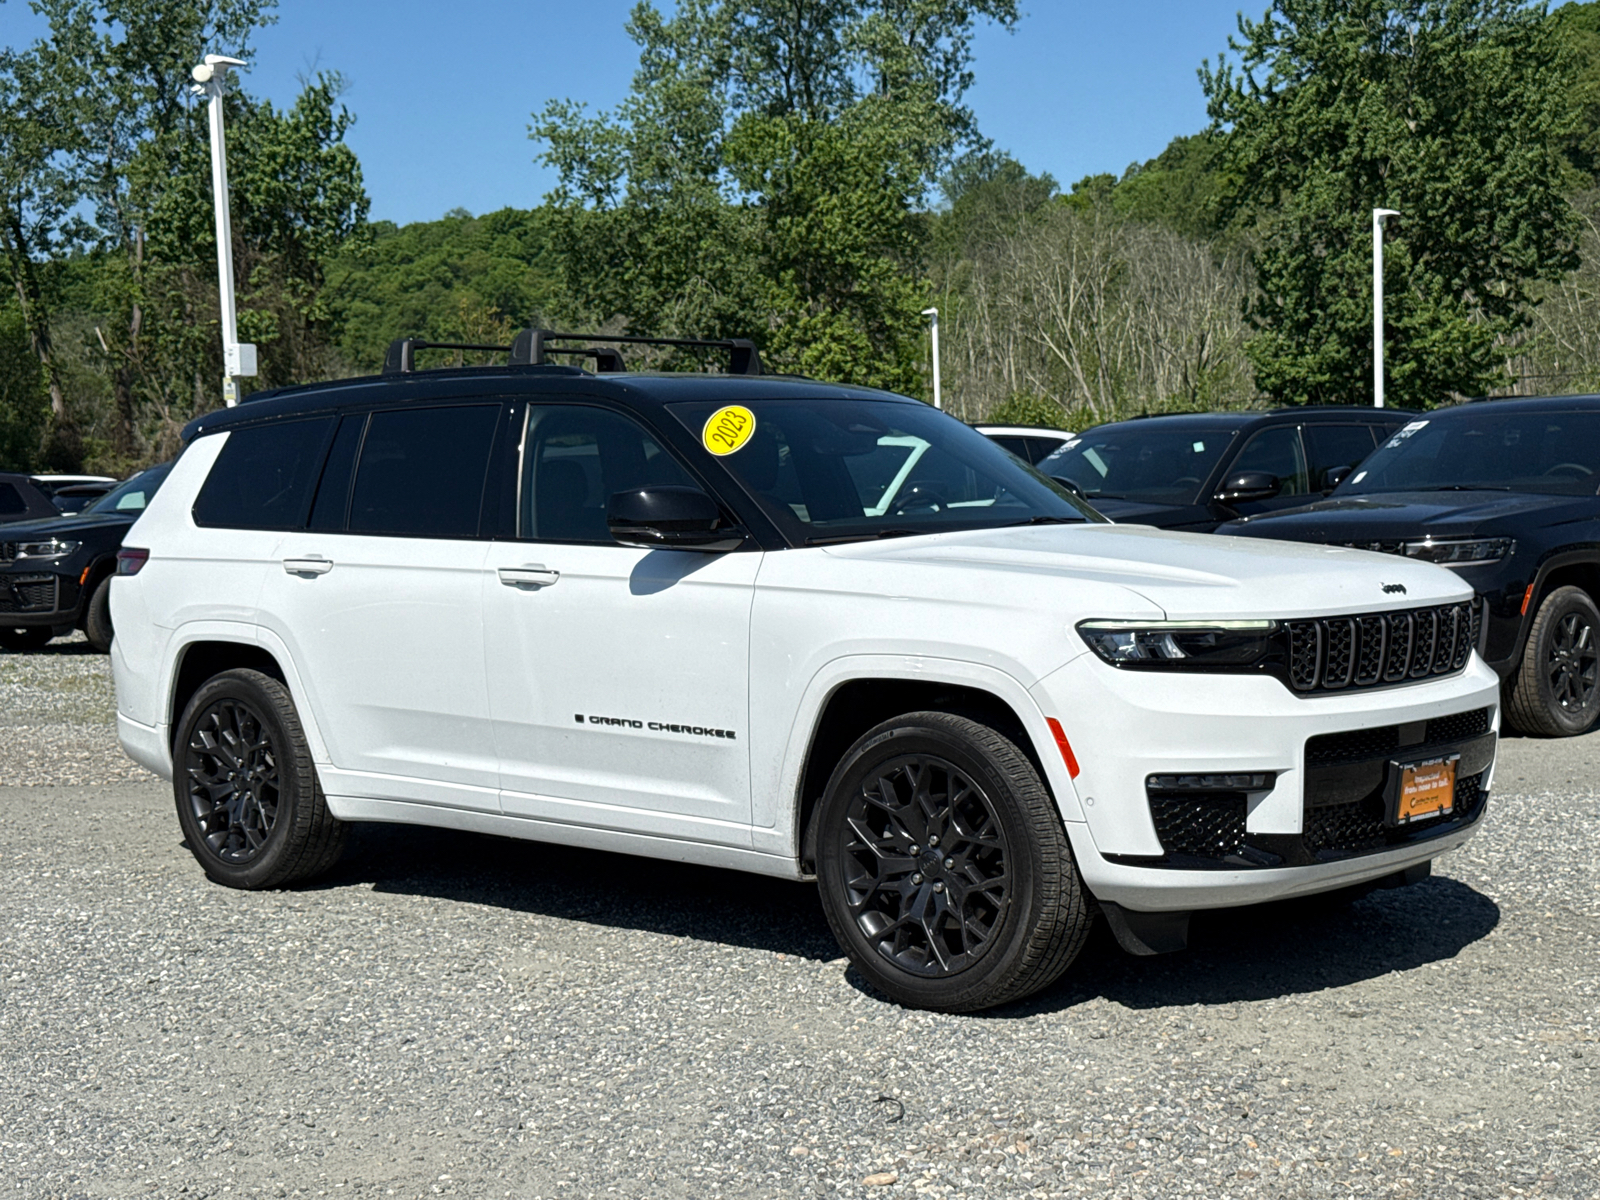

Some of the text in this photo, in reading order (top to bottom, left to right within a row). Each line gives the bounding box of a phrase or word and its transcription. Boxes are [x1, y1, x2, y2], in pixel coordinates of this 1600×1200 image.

[712, 411, 747, 448] 2023
[589, 715, 737, 740] GRAND CHEROKEE
